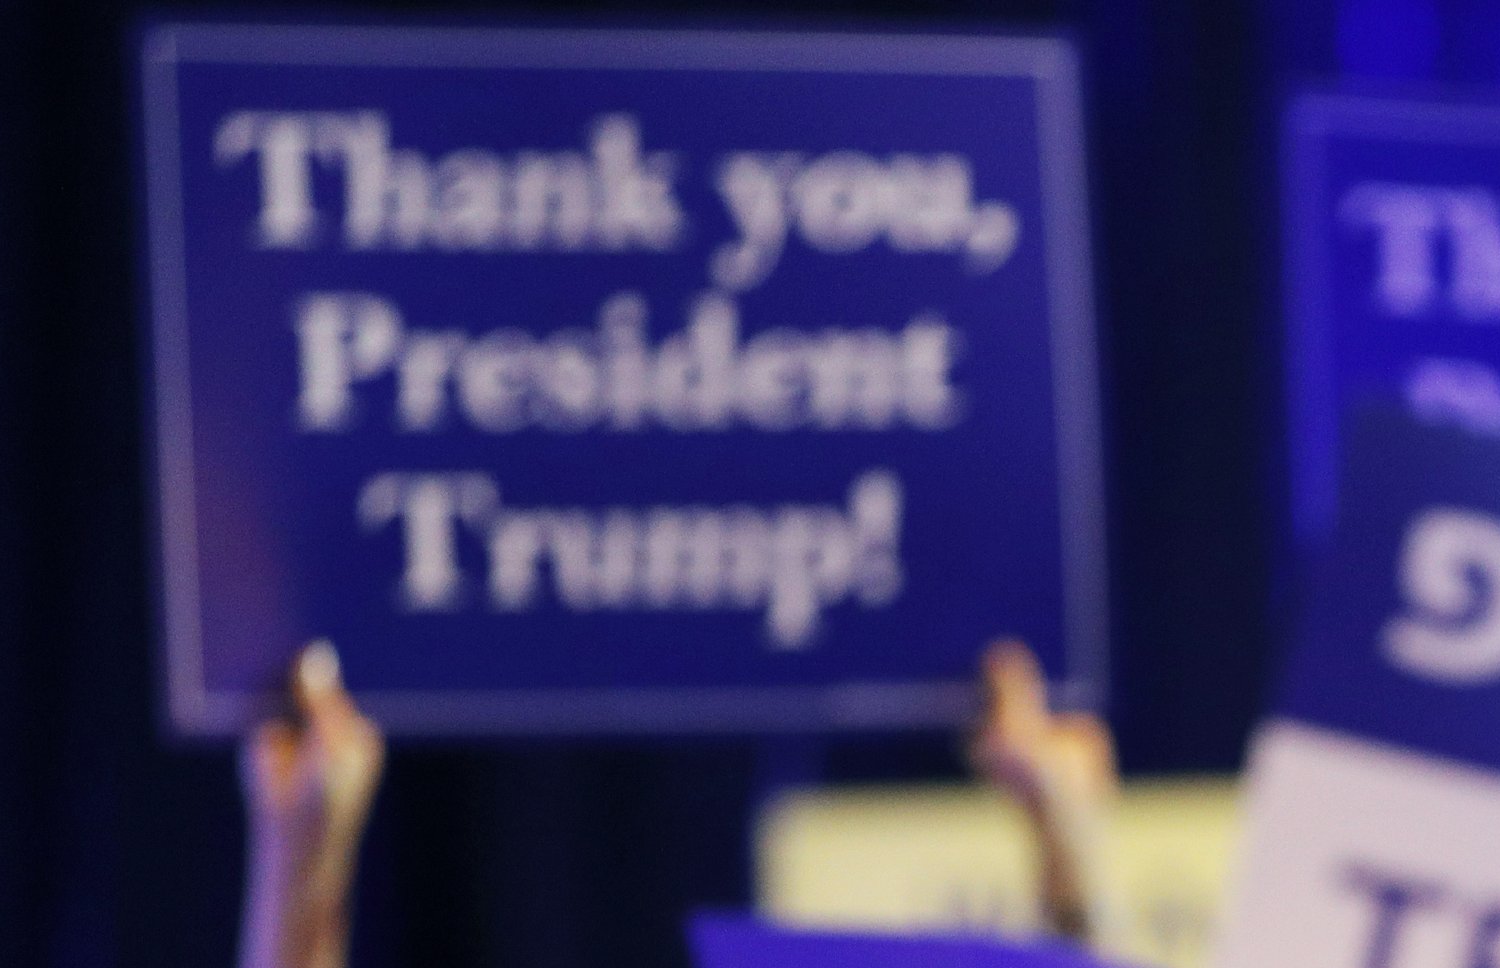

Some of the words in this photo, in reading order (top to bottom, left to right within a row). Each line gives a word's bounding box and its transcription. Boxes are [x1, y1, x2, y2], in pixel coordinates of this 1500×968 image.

[213, 111, 684, 249] Thank
[709, 150, 1017, 291] you,
[297, 291, 961, 430] President
[358, 468, 901, 648] Trump!
